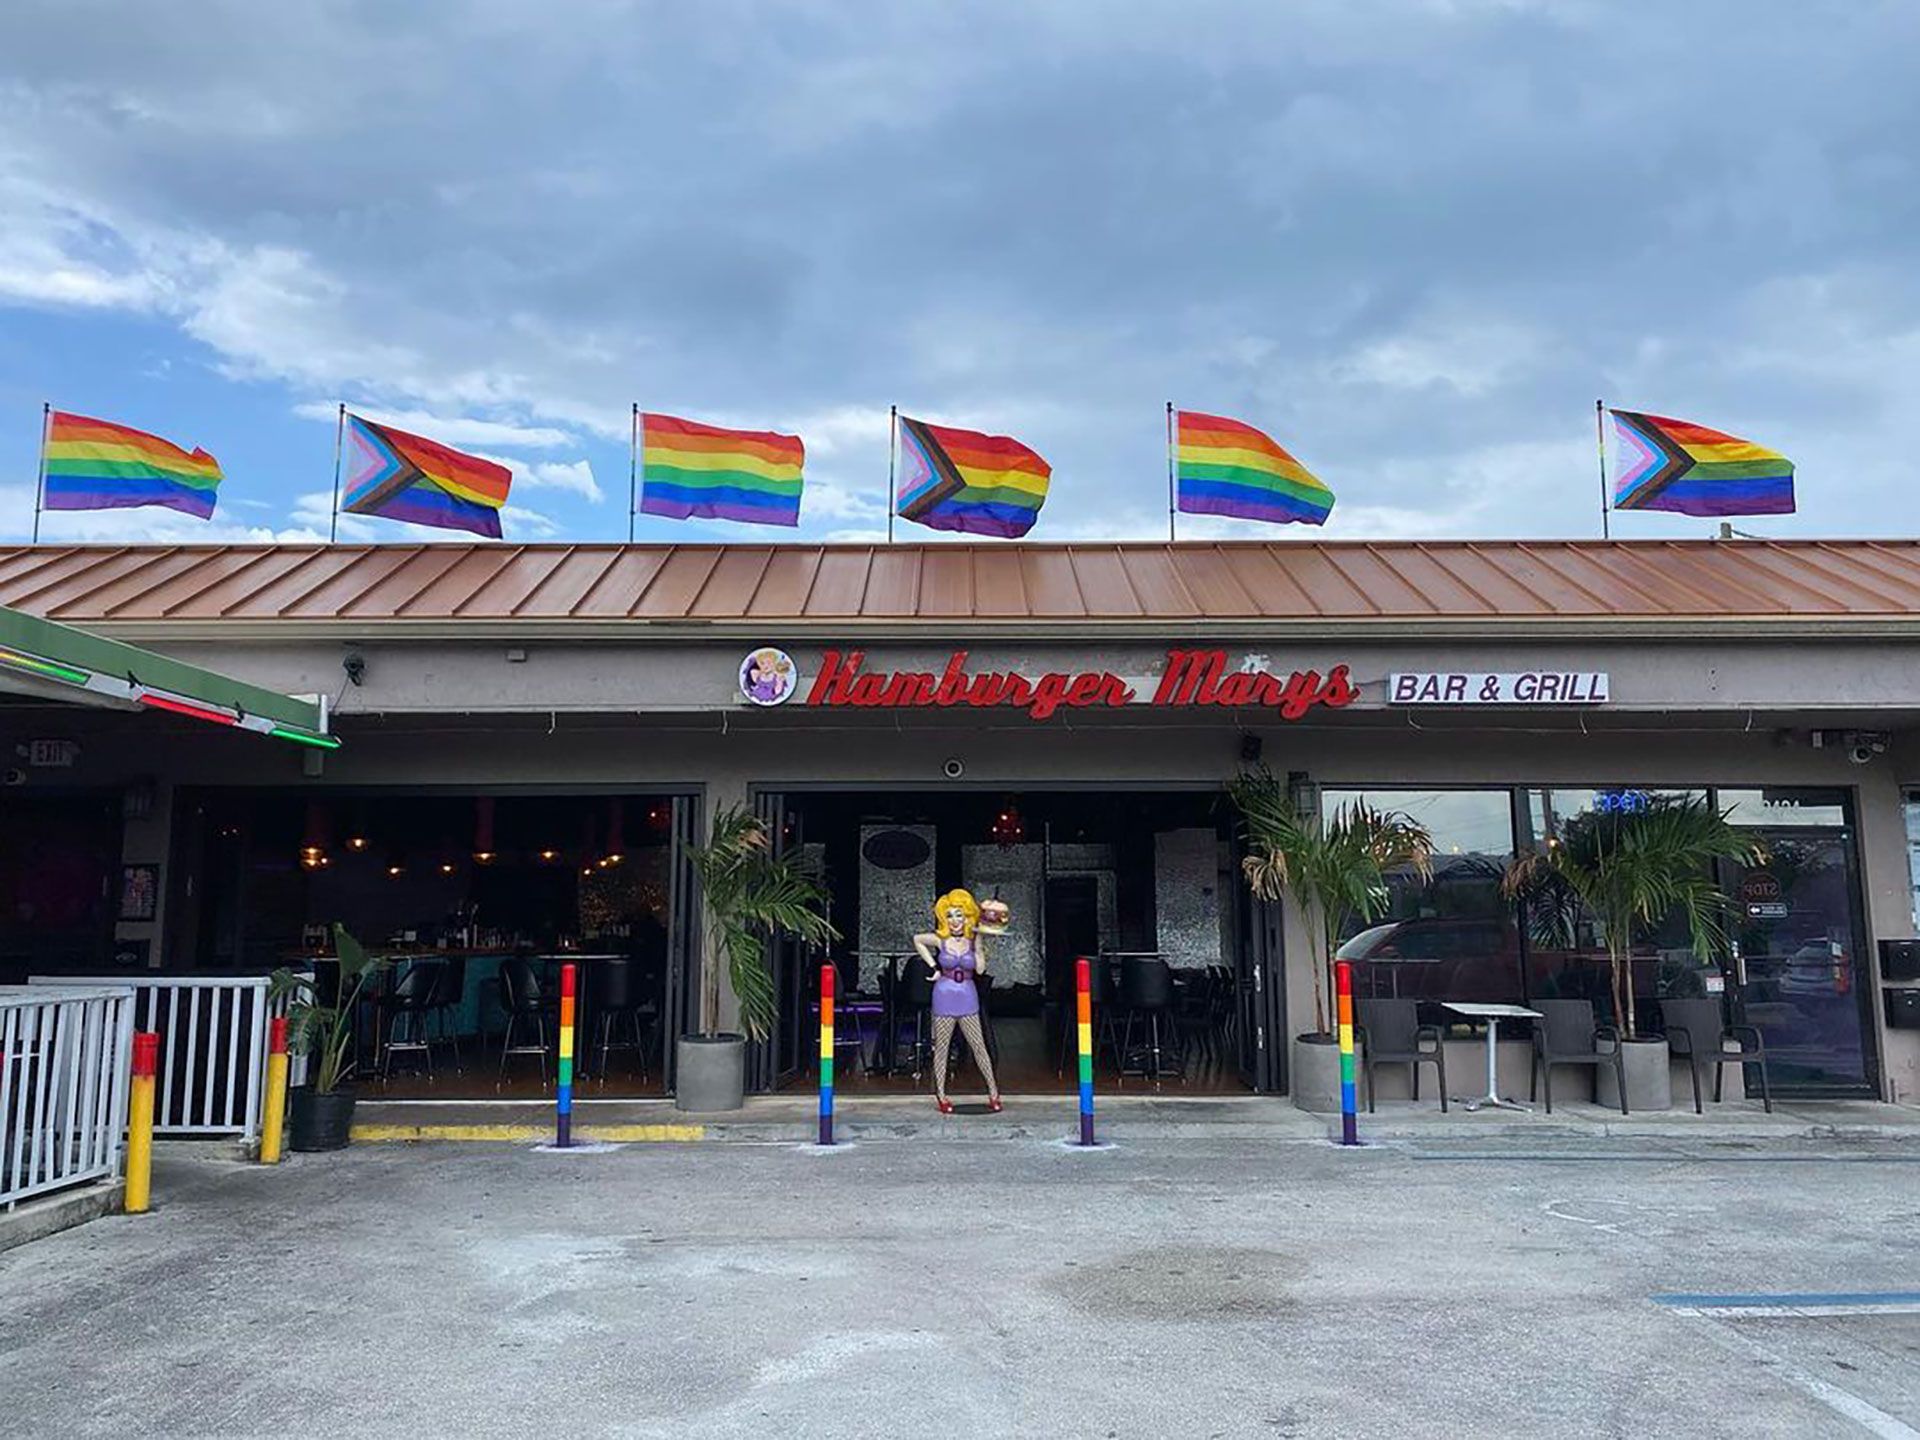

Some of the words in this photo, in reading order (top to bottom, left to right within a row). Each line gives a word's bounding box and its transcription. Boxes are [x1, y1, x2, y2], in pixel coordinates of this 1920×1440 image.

[807, 650, 1136, 719] Hamburger
[1156, 649, 1360, 720] Marys
[1395, 675, 1465, 701] BAR
[1479, 675, 1500, 701] &
[1512, 674, 1606, 701] GRILL
